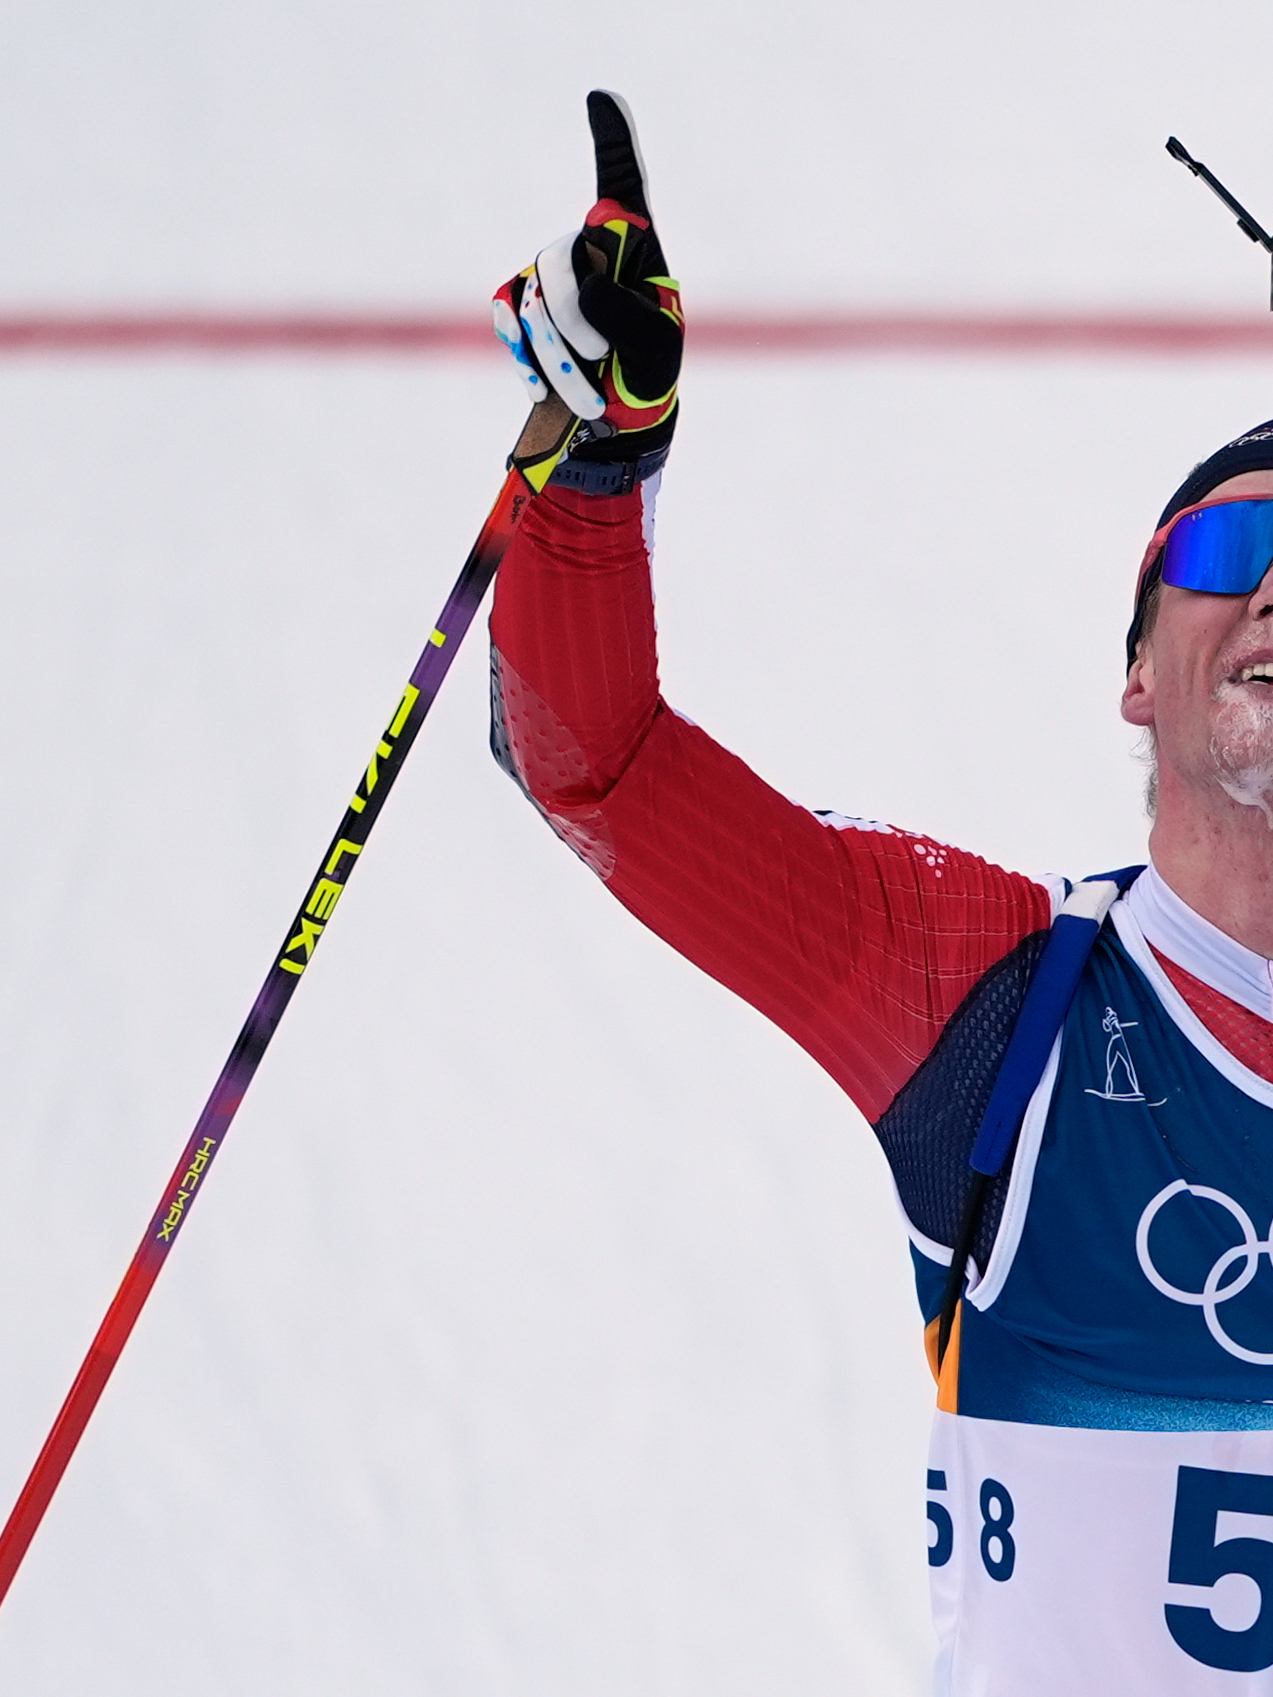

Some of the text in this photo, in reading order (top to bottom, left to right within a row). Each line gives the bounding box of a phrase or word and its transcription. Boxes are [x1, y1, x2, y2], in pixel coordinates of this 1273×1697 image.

[278, 837, 363, 975] LEKI
[156, 1136, 216, 1242] HRC MAX
